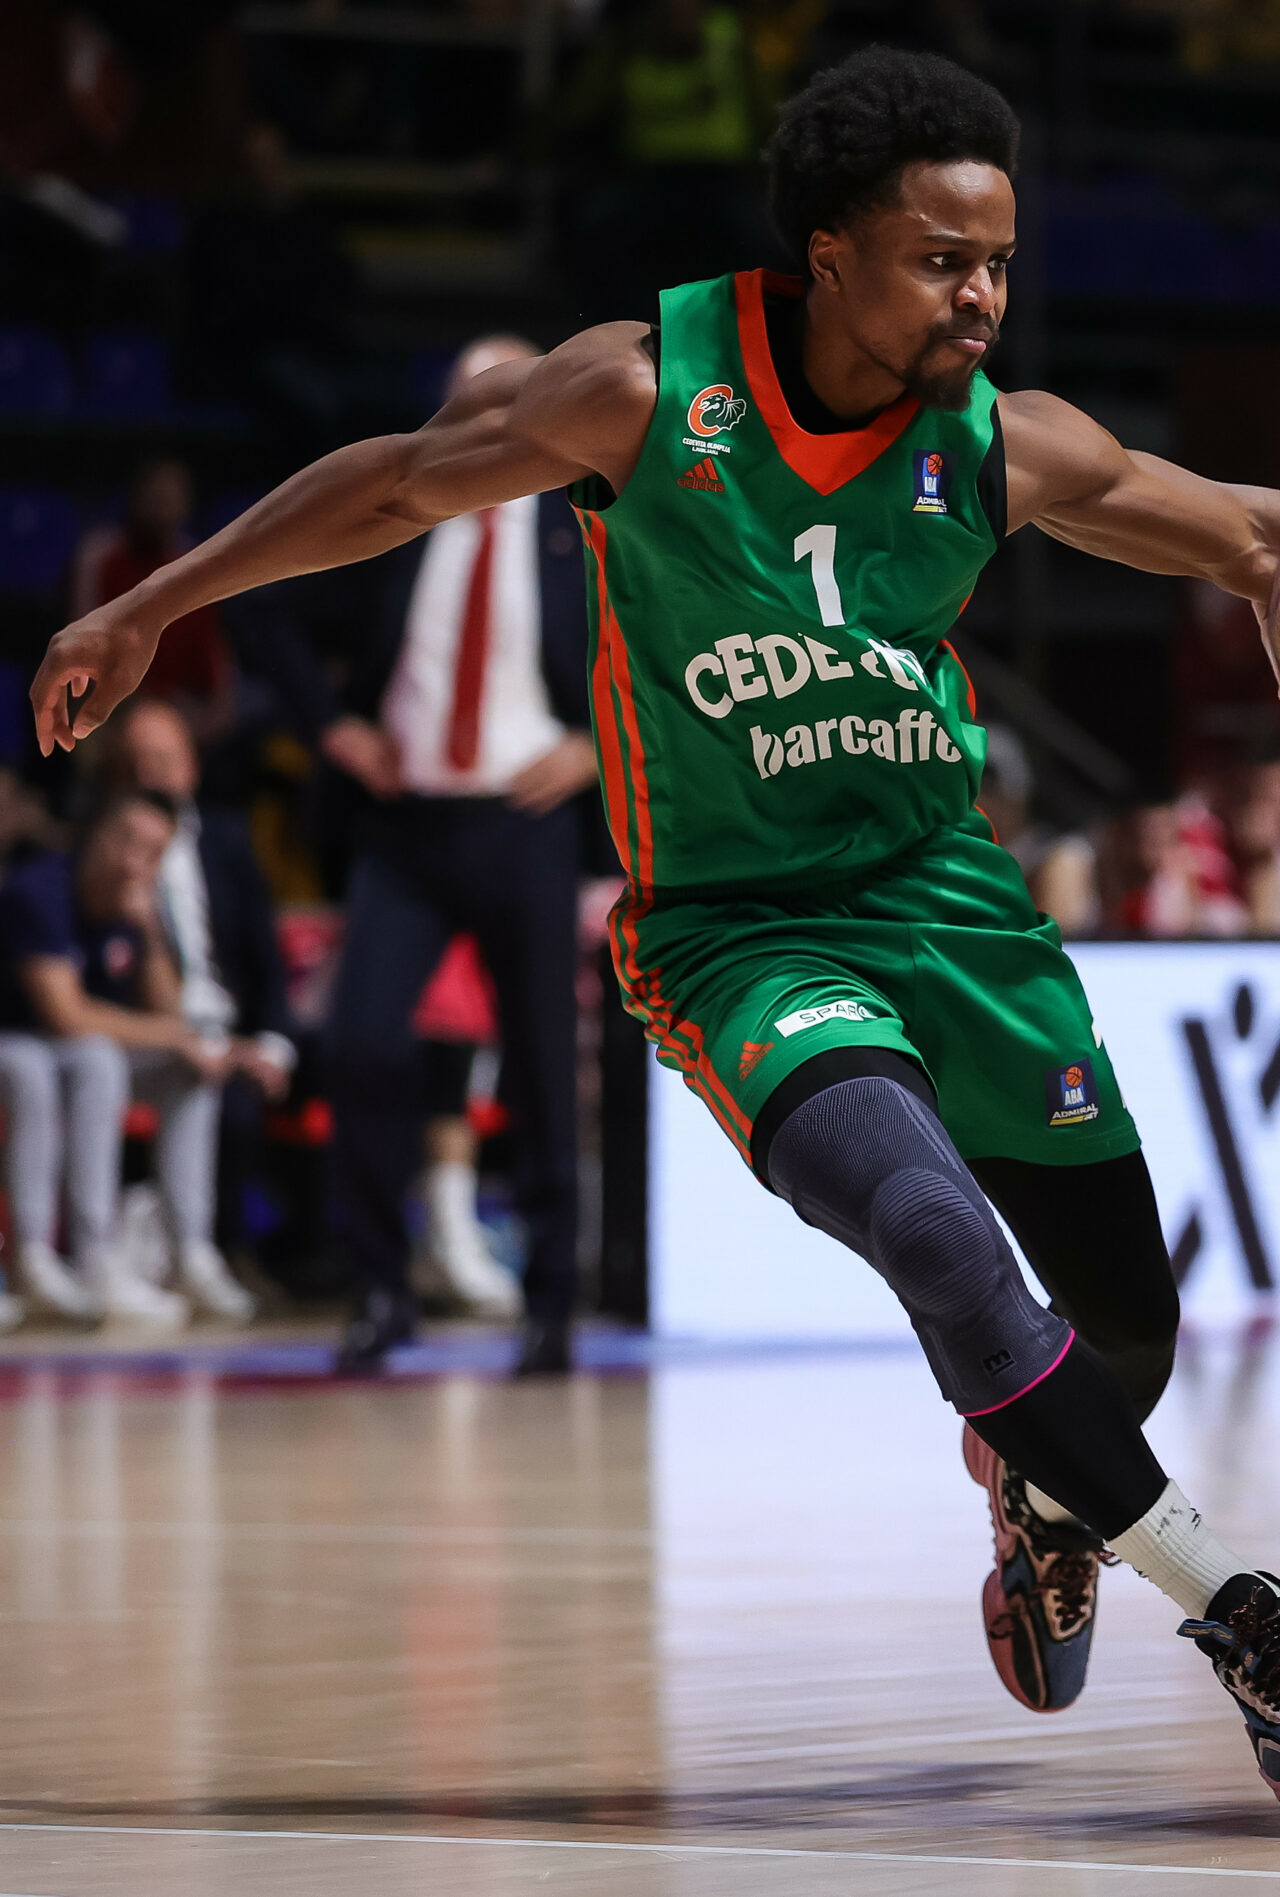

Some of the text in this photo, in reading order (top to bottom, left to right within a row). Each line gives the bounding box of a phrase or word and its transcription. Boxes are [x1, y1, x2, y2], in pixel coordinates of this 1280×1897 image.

[677, 478, 724, 492] adidas
[794, 525, 846, 627] 1
[685, 633, 926, 719] CEDE
[1064, 1087, 1084, 1106] ABA
[1052, 1103, 1099, 1120] ADMIRAL
